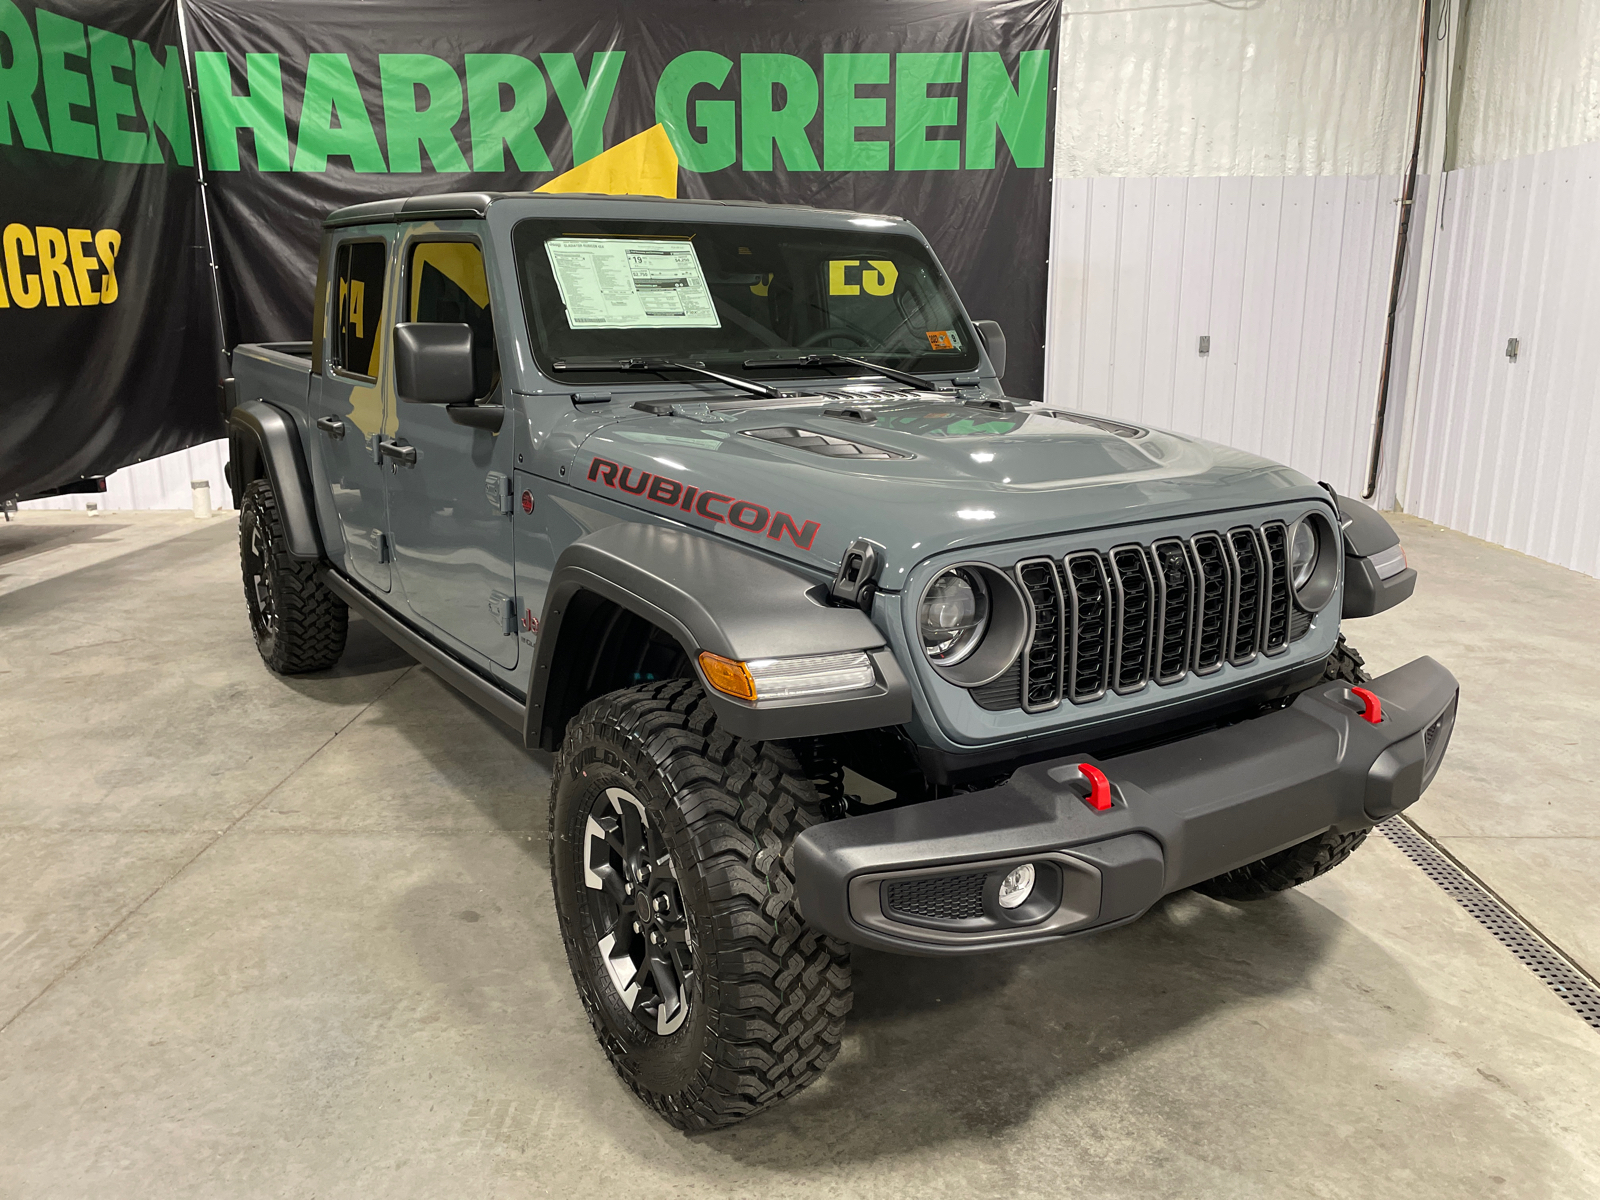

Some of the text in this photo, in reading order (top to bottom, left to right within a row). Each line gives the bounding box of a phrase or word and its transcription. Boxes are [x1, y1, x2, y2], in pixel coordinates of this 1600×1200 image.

[195, 50, 1050, 173] HARRY GREEN
[0, 223, 122, 309] CRES
[587, 456, 821, 551] RUBICON
